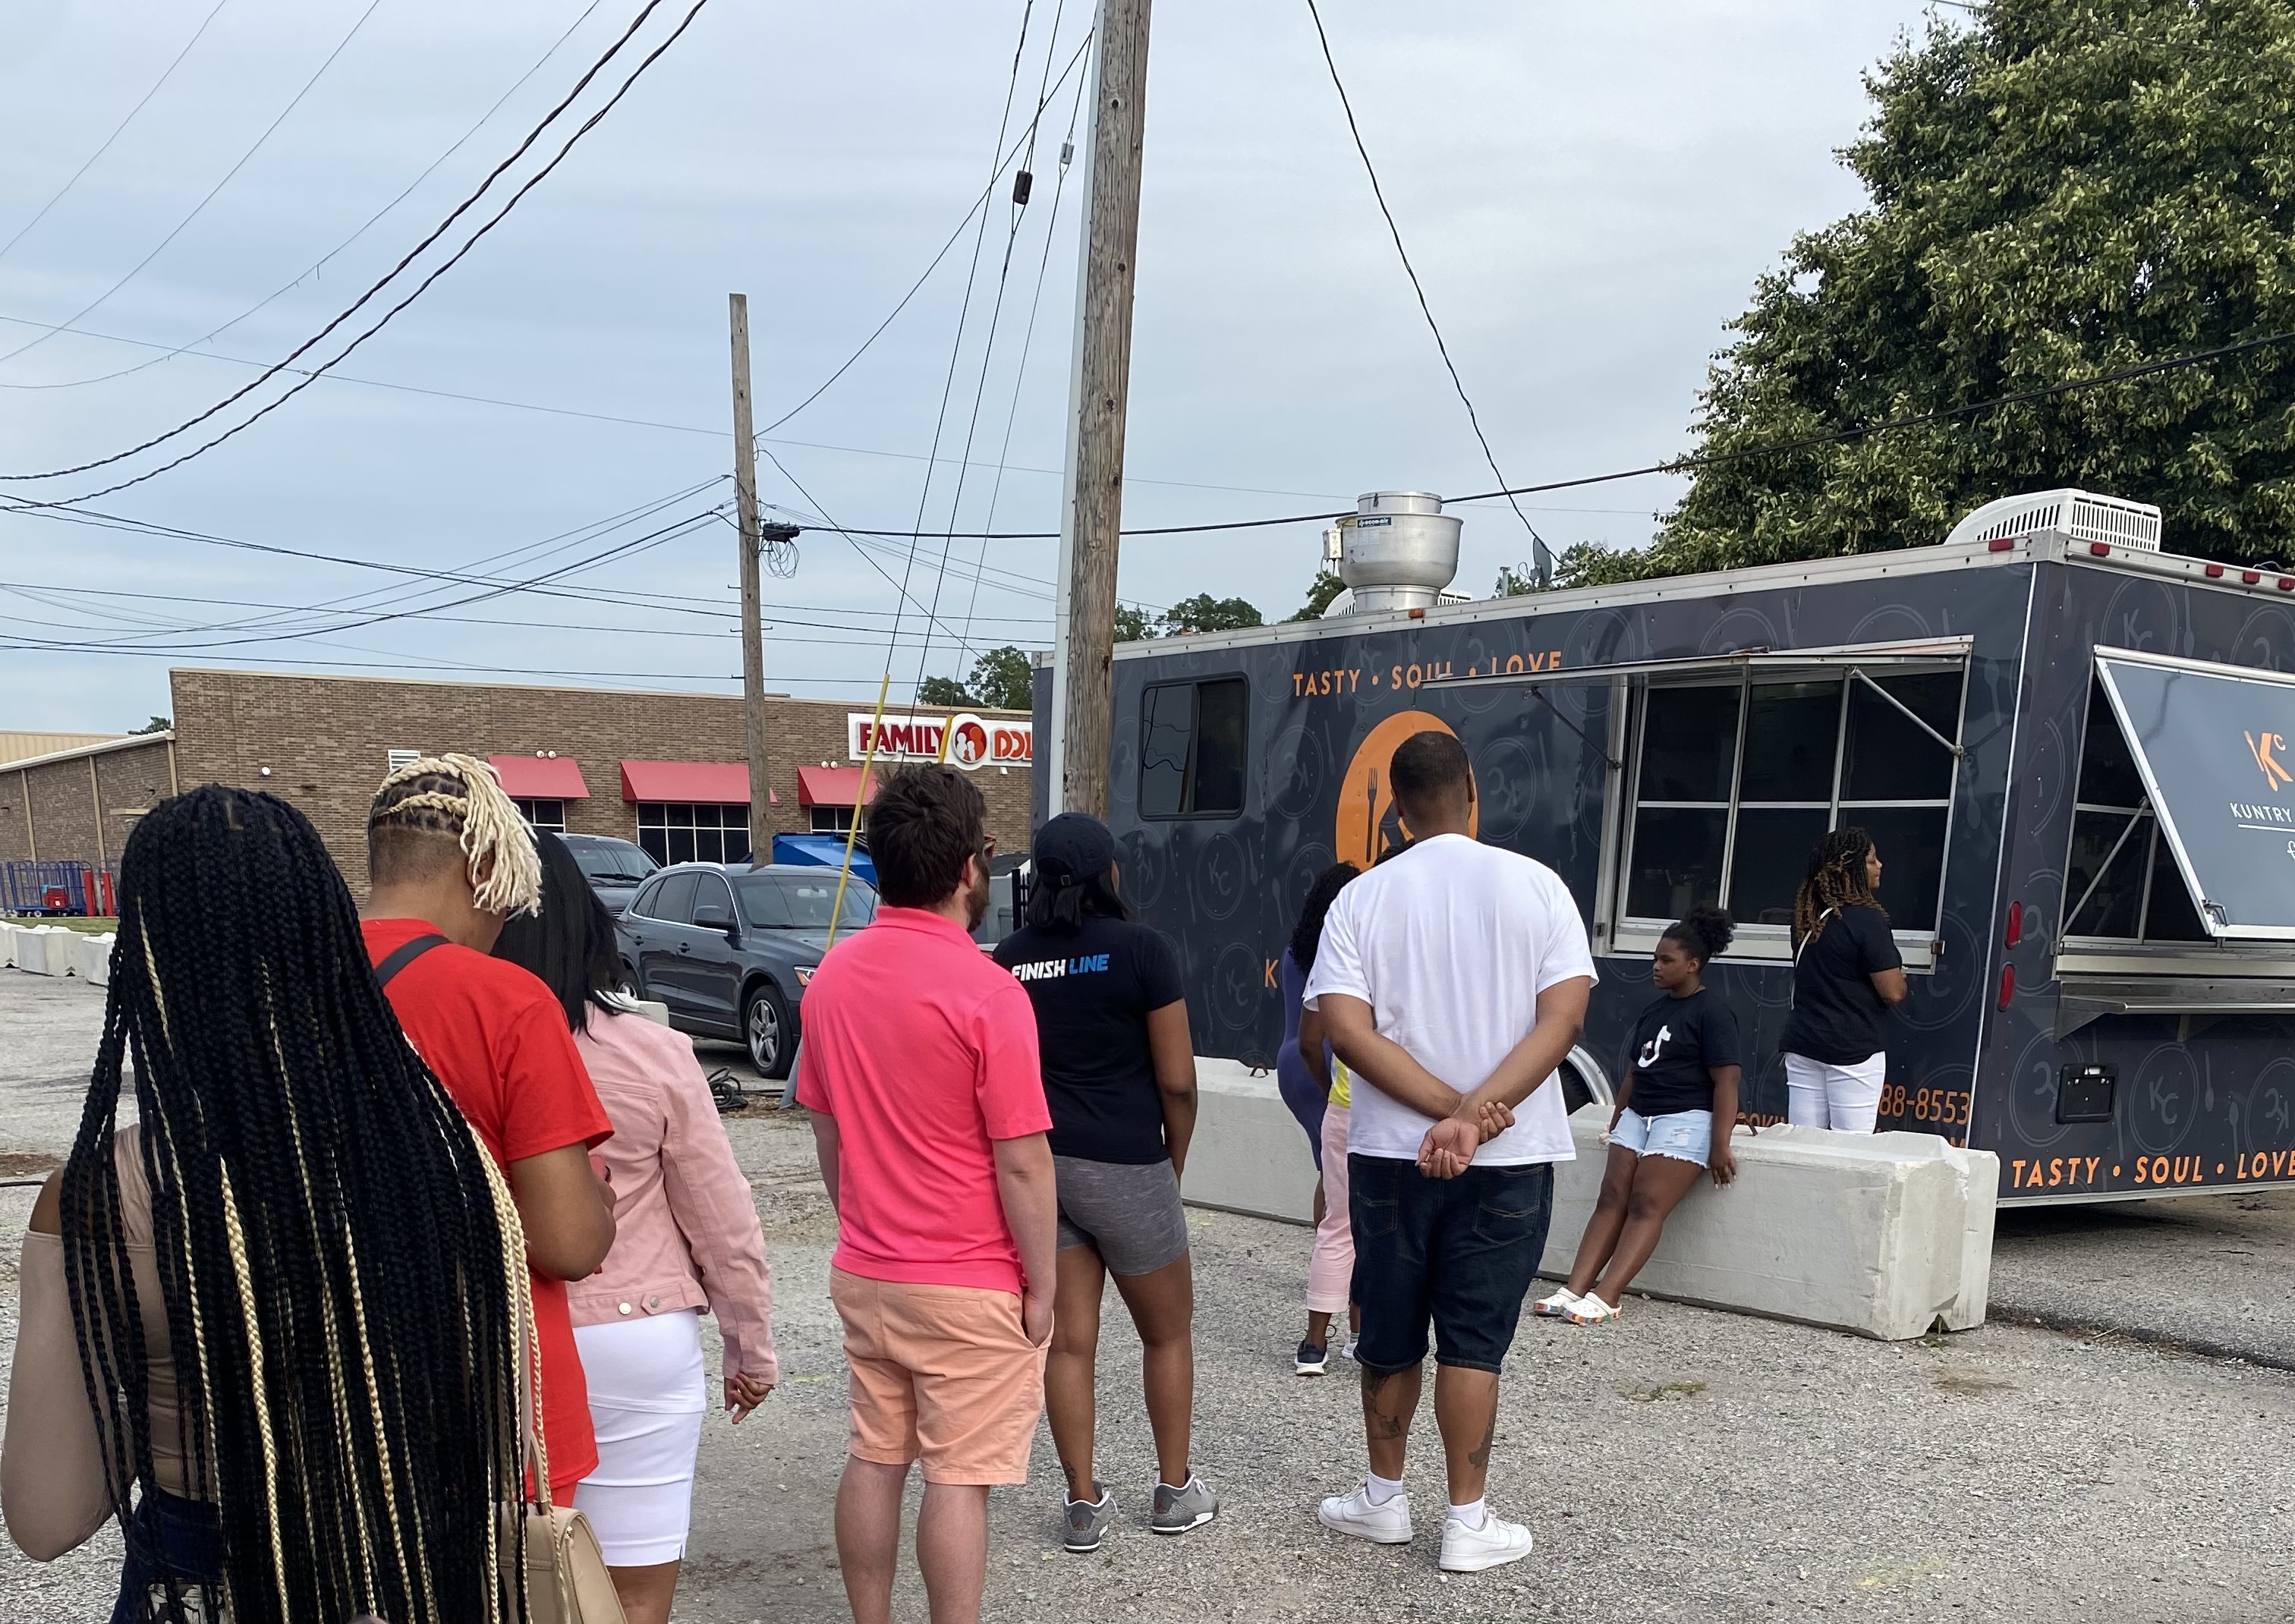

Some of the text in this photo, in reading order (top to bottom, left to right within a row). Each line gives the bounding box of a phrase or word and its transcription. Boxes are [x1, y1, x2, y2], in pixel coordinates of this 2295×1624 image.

[1292, 669, 1361, 697] TASTY
[858, 722, 946, 756] FAMILY
[2229, 801, 2293, 823] KUNTRY
[1011, 953, 1110, 981] FINISH LINE
[1878, 1083, 1971, 1125] 88-8553
[2012, 1157, 2101, 1188] TASTY
[2133, 1155, 2204, 1185] SOUL
